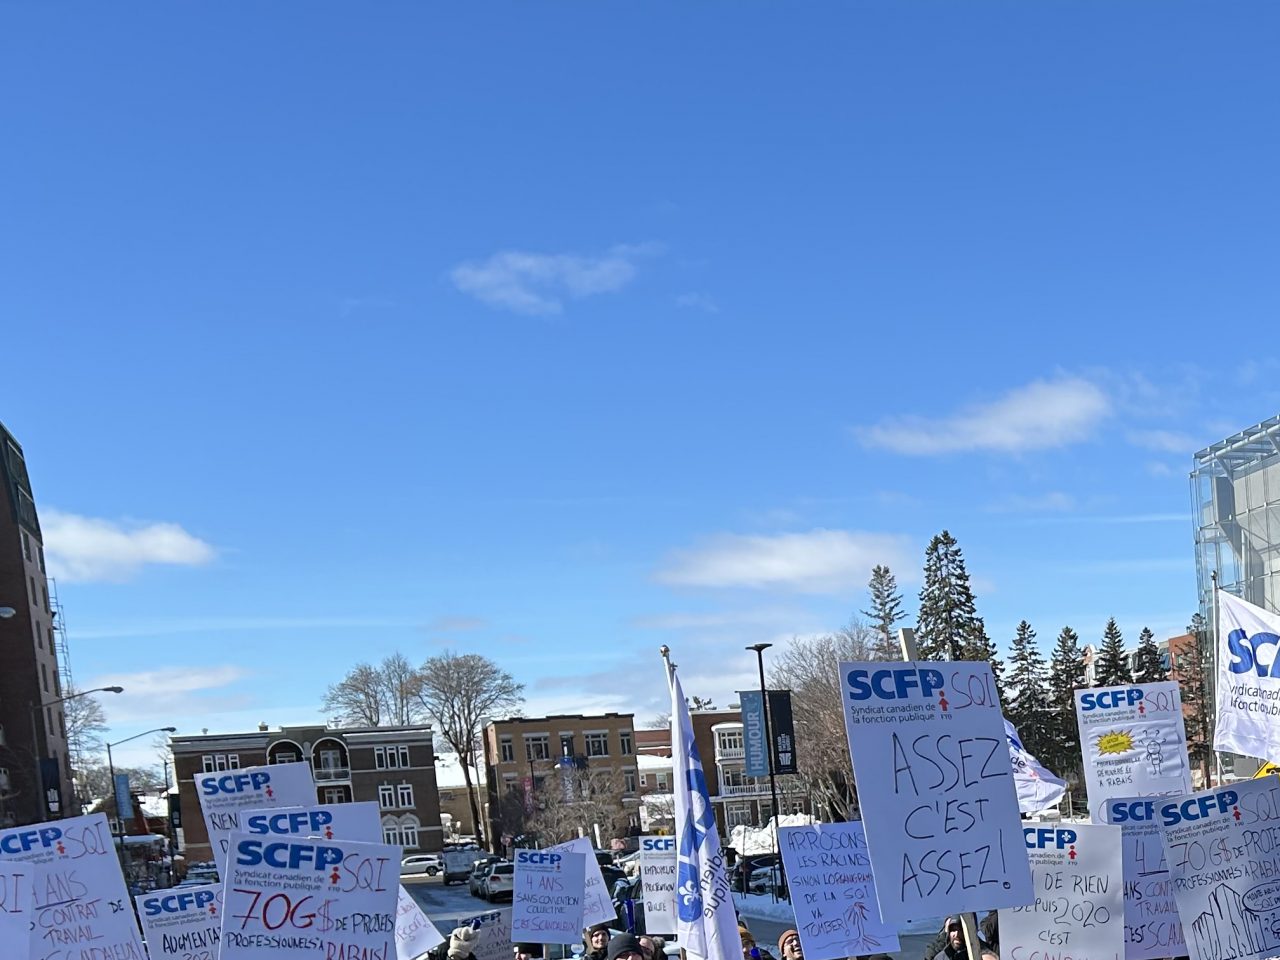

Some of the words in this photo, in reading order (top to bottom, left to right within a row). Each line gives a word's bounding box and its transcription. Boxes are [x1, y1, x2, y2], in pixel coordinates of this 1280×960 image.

[847, 669, 944, 700] SCFP
[951, 671, 996, 710] SQI
[851, 704, 886, 716] Syndicat
[888, 702, 923, 714] canadien
[1081, 688, 1144, 711] SCFP
[1144, 689, 1178, 713] SQI
[861, 714, 897, 724] fonction
[898, 712, 935, 724] publique
[747, 711, 763, 770] HUMOUR
[892, 732, 1008, 795] ASSEZ
[1010, 756, 1026, 768] de
[201, 772, 271, 796] SCFP
[1106, 775, 1133, 787] RABAIS
[904, 798, 989, 839] C'EST
[1161, 790, 1238, 827] SCFP
[208, 812, 239, 832] RIEN
[248, 810, 333, 835] SCFP
[1165, 824, 1193, 837] Syndicat
[1193, 819, 1221, 831] canadien
[1173, 830, 1201, 842] fonction
[1202, 823, 1230, 836] publique
[0, 826, 62, 854] CFP
[65, 821, 108, 859] SQI
[787, 831, 868, 851] ARROSONS
[1023, 828, 1077, 849] CFP
[236, 840, 344, 871] SCFP
[518, 851, 562, 865] SCFP
[797, 856, 818, 869] LES
[820, 852, 871, 867] RACINES
[1232, 844, 1244, 858] DE
[342, 853, 391, 893] SQI
[901, 829, 1011, 902] ASSEZ!
[1035, 859, 1063, 867] publique
[234, 869, 271, 883] Syndicat
[272, 871, 312, 883] canadien
[244, 877, 281, 890] fonction
[283, 879, 322, 892] publique
[539, 876, 564, 892] ANS
[792, 874, 820, 887] SINON
[1045, 872, 1063, 890] DE
[1071, 874, 1109, 896] RIEN
[144, 890, 214, 916] SCFP
[515, 893, 538, 905] SANS
[804, 892, 817, 904] DE
[824, 891, 837, 901] LA
[39, 898, 100, 929] CONTRAT
[108, 899, 124, 914] DE
[803, 910, 851, 937] TOMBER!
[811, 907, 823, 919] VA
[1054, 897, 1110, 928] 2020
[335, 918, 348, 931] DE
[352, 913, 394, 935] PROJETS
[43, 925, 104, 949] TRAVAIL
[1038, 929, 1072, 945] C'EST
